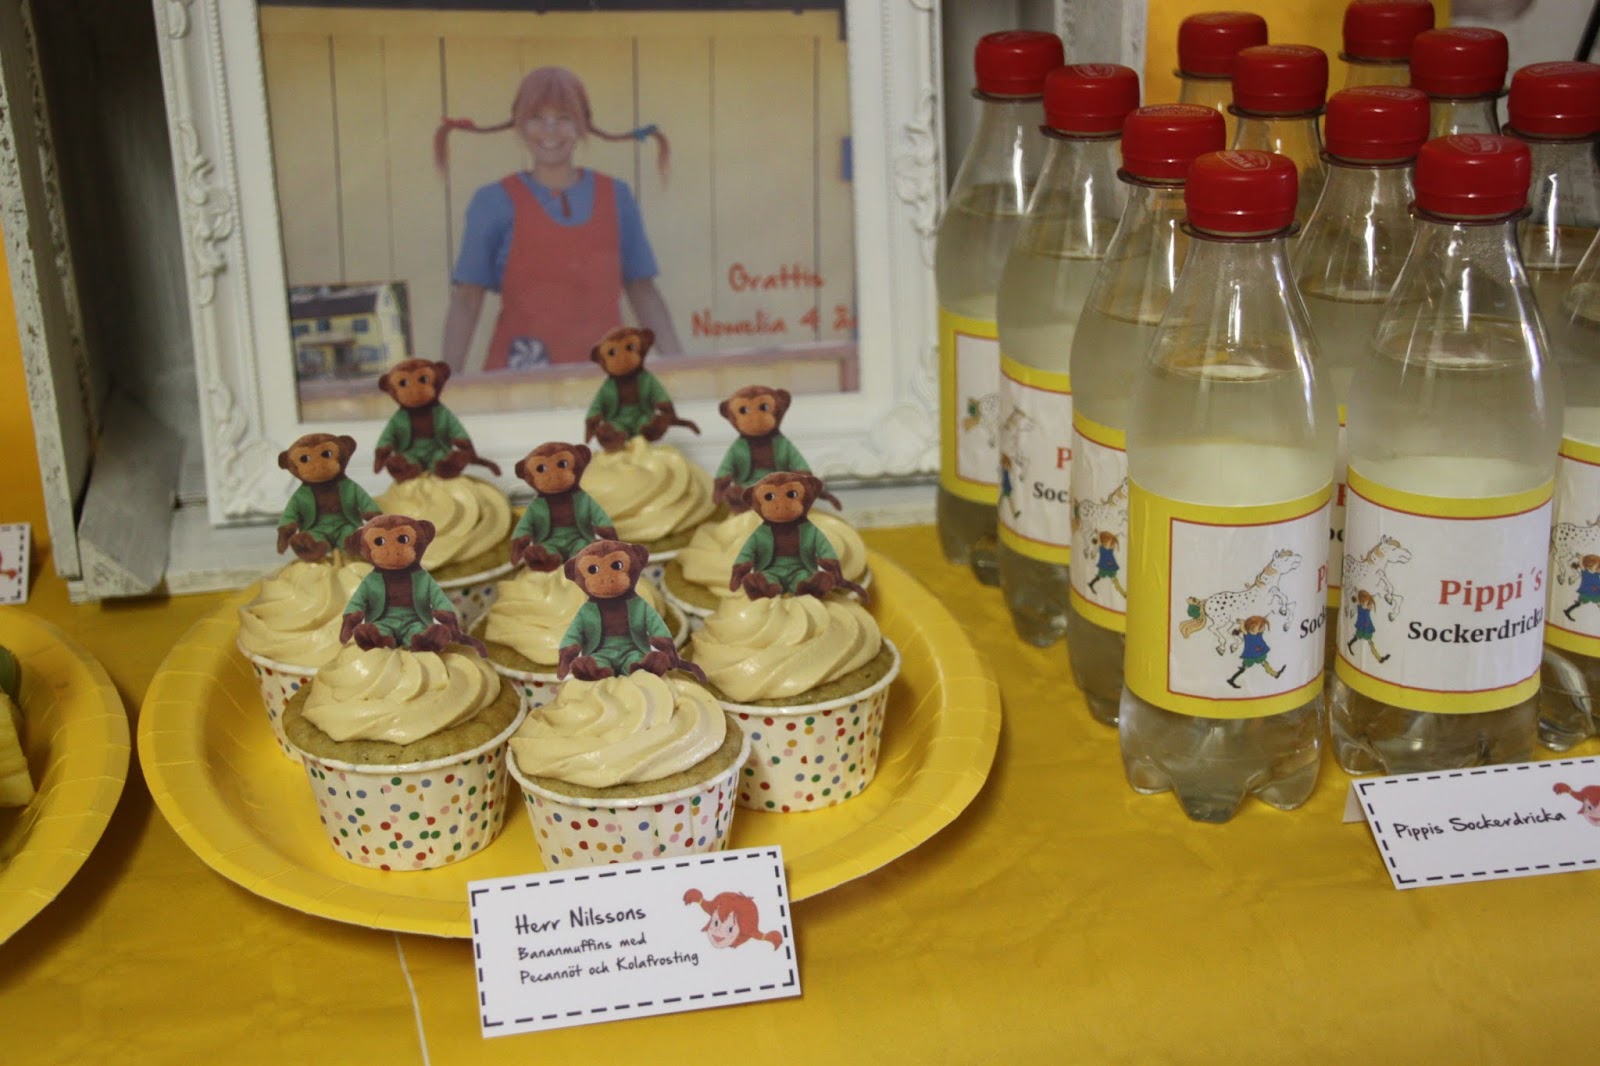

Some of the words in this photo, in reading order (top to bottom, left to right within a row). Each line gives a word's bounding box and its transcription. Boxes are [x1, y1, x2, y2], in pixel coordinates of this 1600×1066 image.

[800, 305, 821, 333] 4
[1033, 481, 1068, 503] Soc
[1393, 822, 1444, 841] Pippis
[1449, 807, 1566, 832] Sockerdricka
[515, 913, 560, 935] Herr
[569, 906, 647, 928] Nilssons
[518, 938, 612, 960] Bananmuffins
[619, 932, 647, 948] med
[520, 964, 582, 985] Pecannöt
[588, 961, 610, 976] och
[616, 950, 699, 973] Kolafrosting
